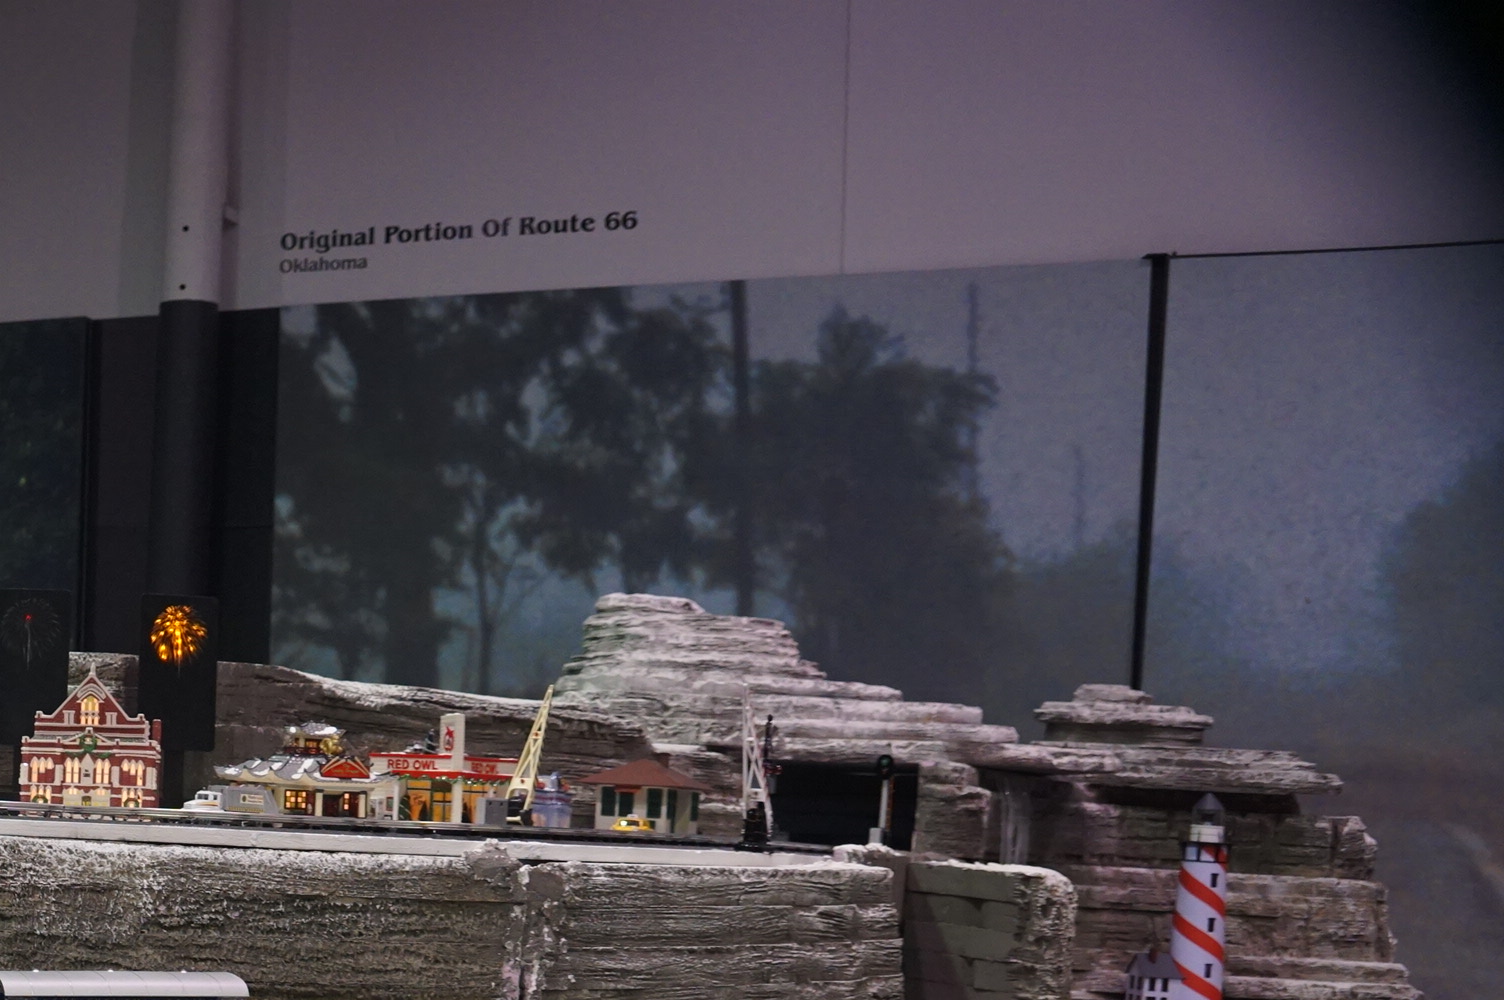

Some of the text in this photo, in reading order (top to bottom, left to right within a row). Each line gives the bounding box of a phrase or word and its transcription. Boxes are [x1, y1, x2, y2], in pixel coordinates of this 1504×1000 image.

[280, 210, 639, 255] Original Portion Of Route 66
[278, 256, 368, 275] Oklahoma
[387, 759, 438, 770] RED OWL
